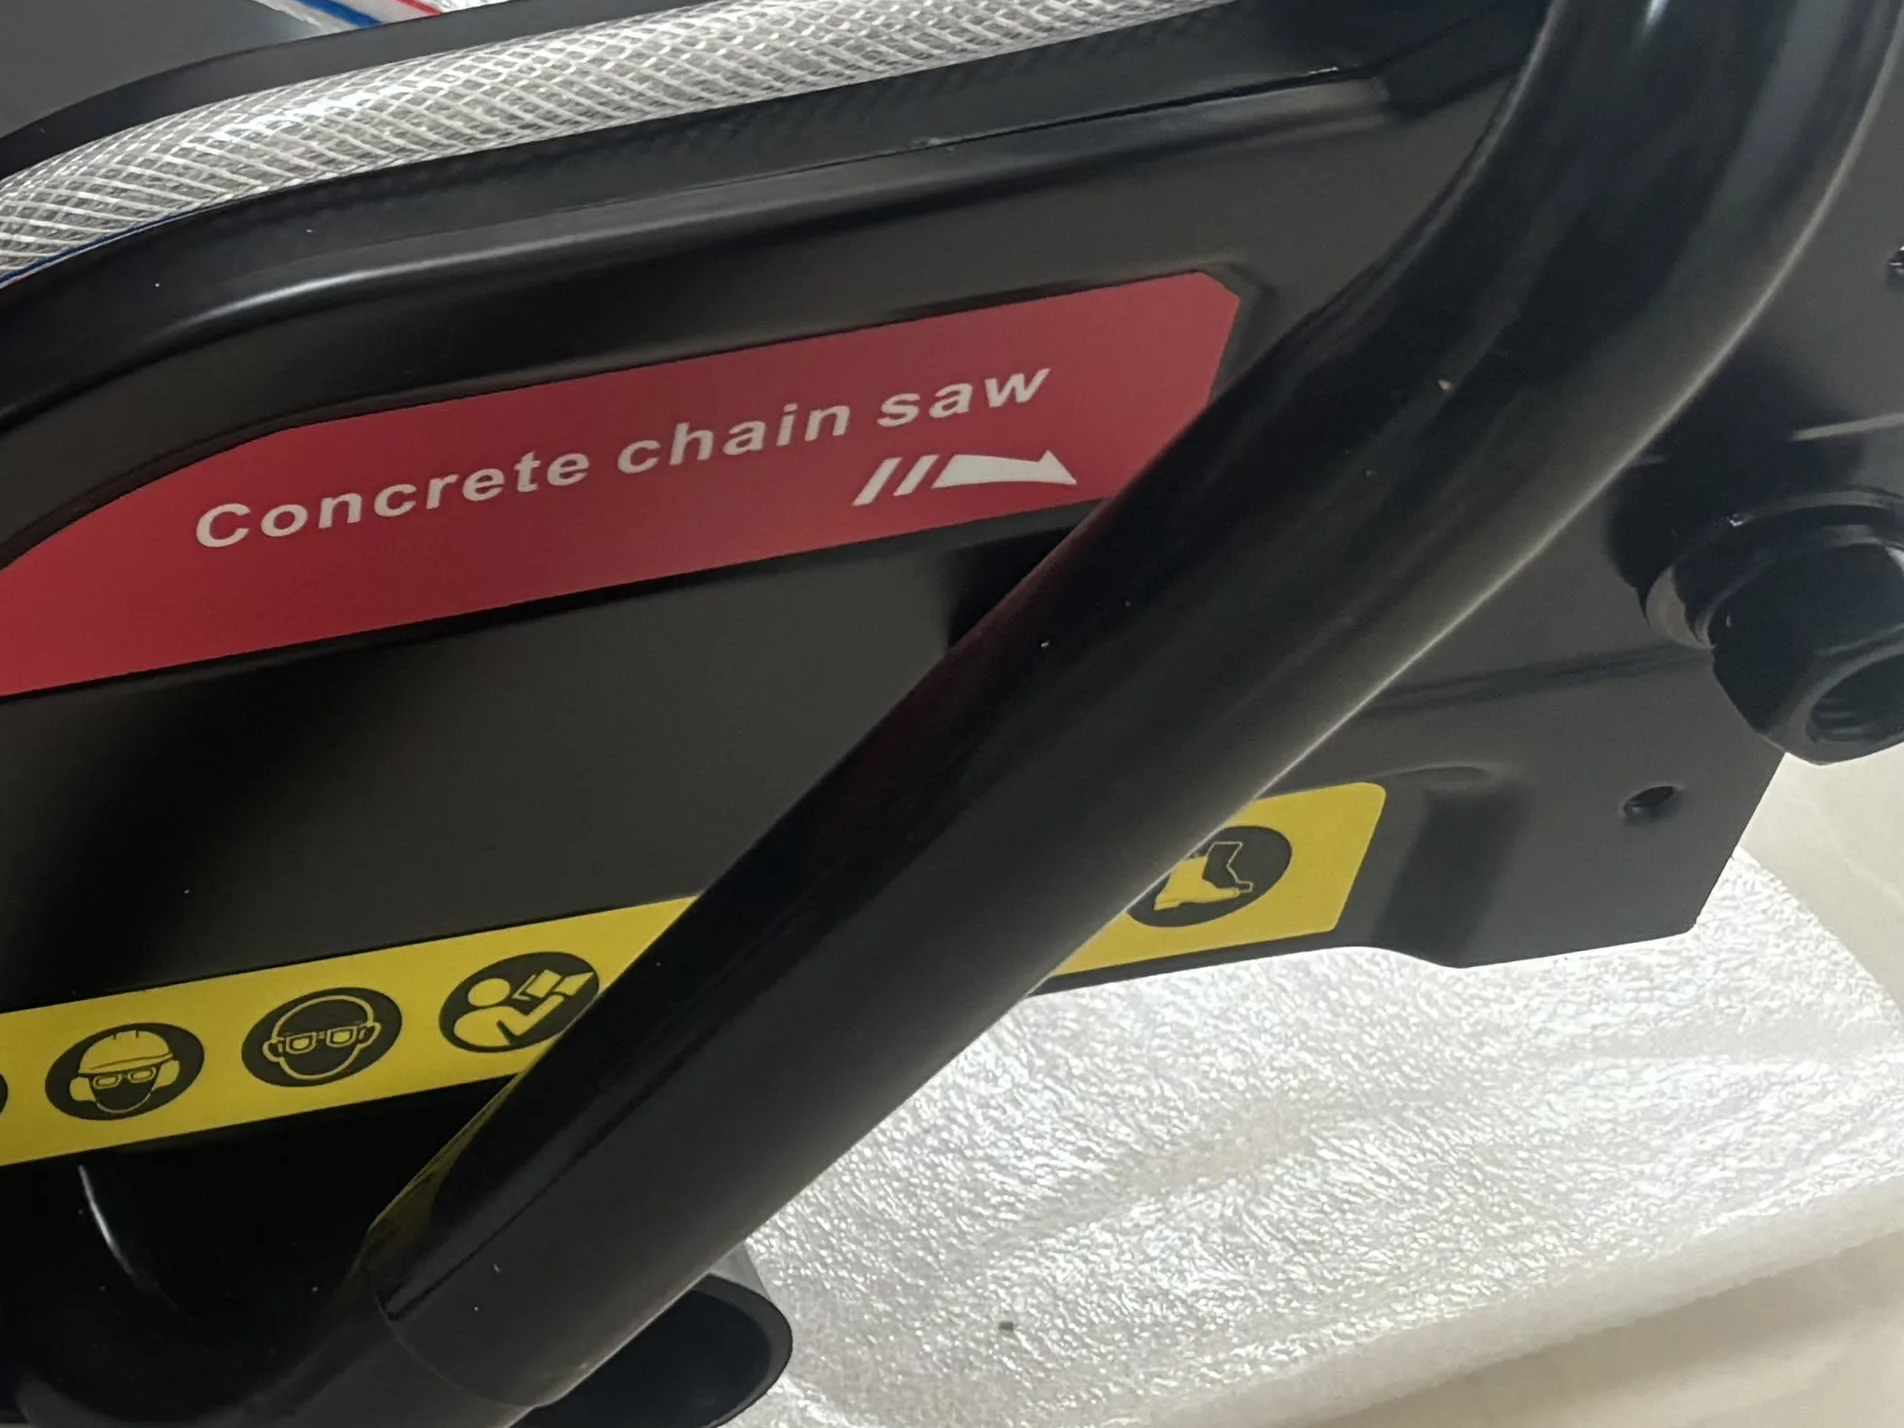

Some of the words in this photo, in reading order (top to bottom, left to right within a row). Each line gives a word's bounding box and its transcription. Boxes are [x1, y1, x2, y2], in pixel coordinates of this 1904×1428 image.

[195, 452, 590, 548] Concrete
[616, 403, 851, 474] chain
[877, 368, 1050, 427] saw
